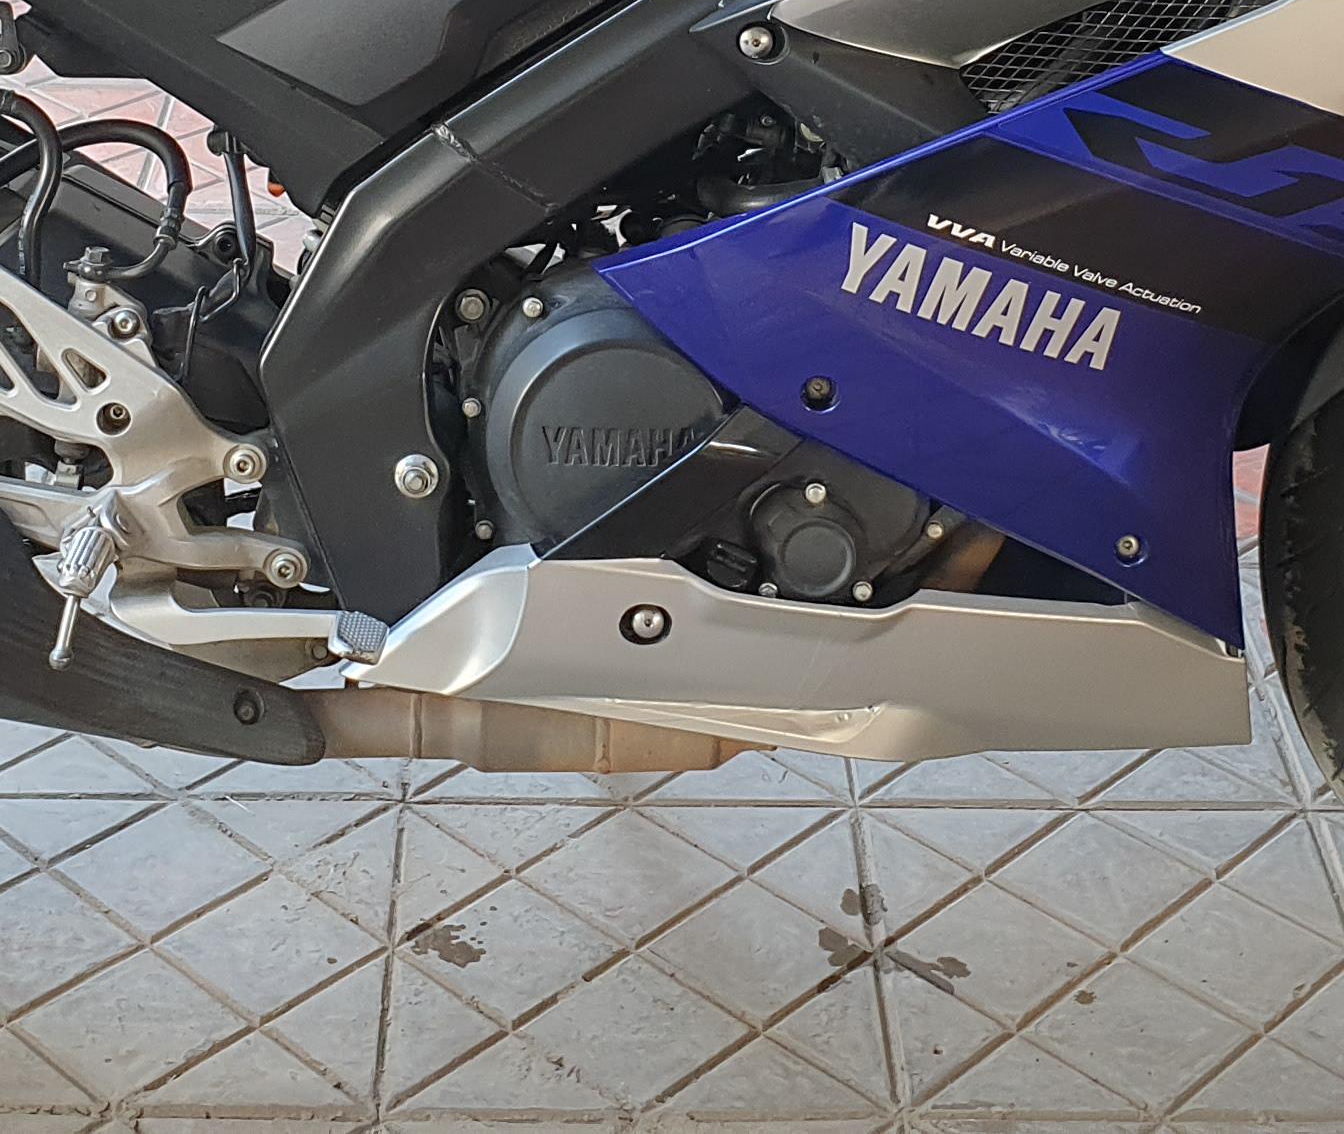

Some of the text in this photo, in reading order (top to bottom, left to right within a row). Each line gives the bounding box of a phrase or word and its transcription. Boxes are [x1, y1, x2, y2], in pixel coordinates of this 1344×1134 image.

[840, 221, 1122, 371] YAMAHA
[927, 213, 1202, 314] VVA Variable Valve Actuation
